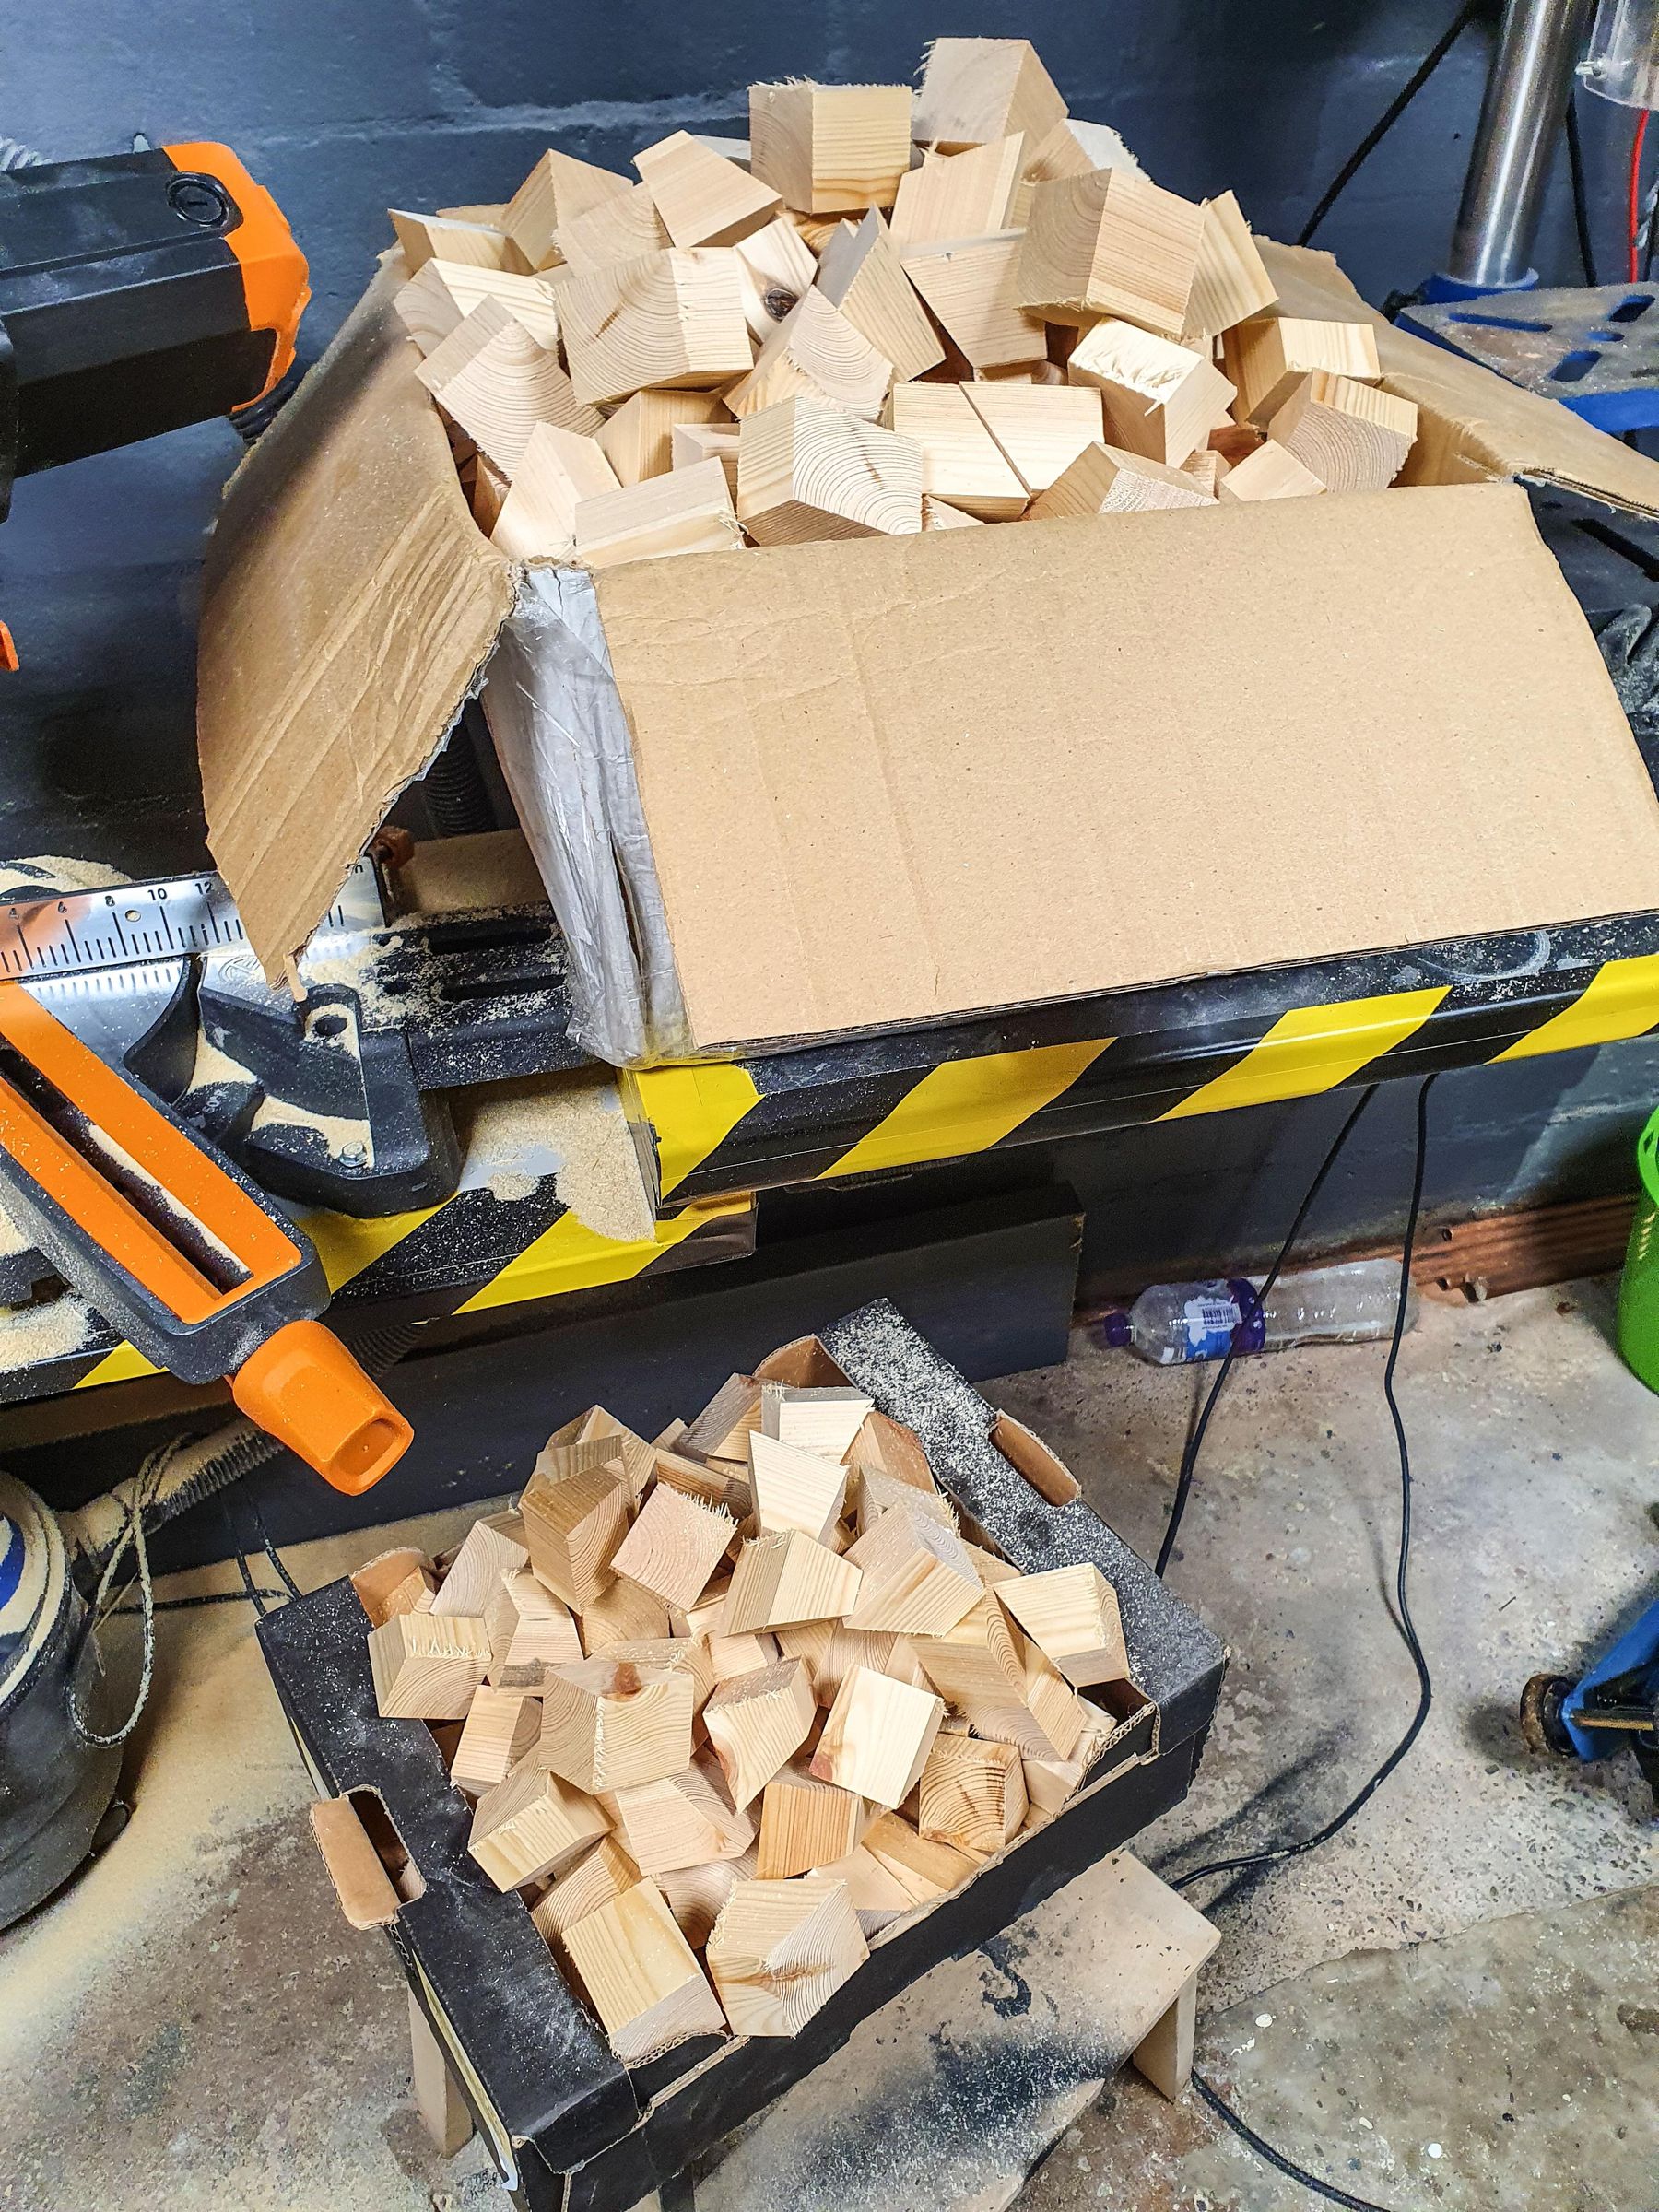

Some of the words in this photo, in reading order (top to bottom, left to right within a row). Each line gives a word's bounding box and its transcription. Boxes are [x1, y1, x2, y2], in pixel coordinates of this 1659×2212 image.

[57, 901, 67, 913] 6
[104, 895, 115, 907] 8
[147, 888, 168, 900] 10
[194, 881, 213, 895] 12
